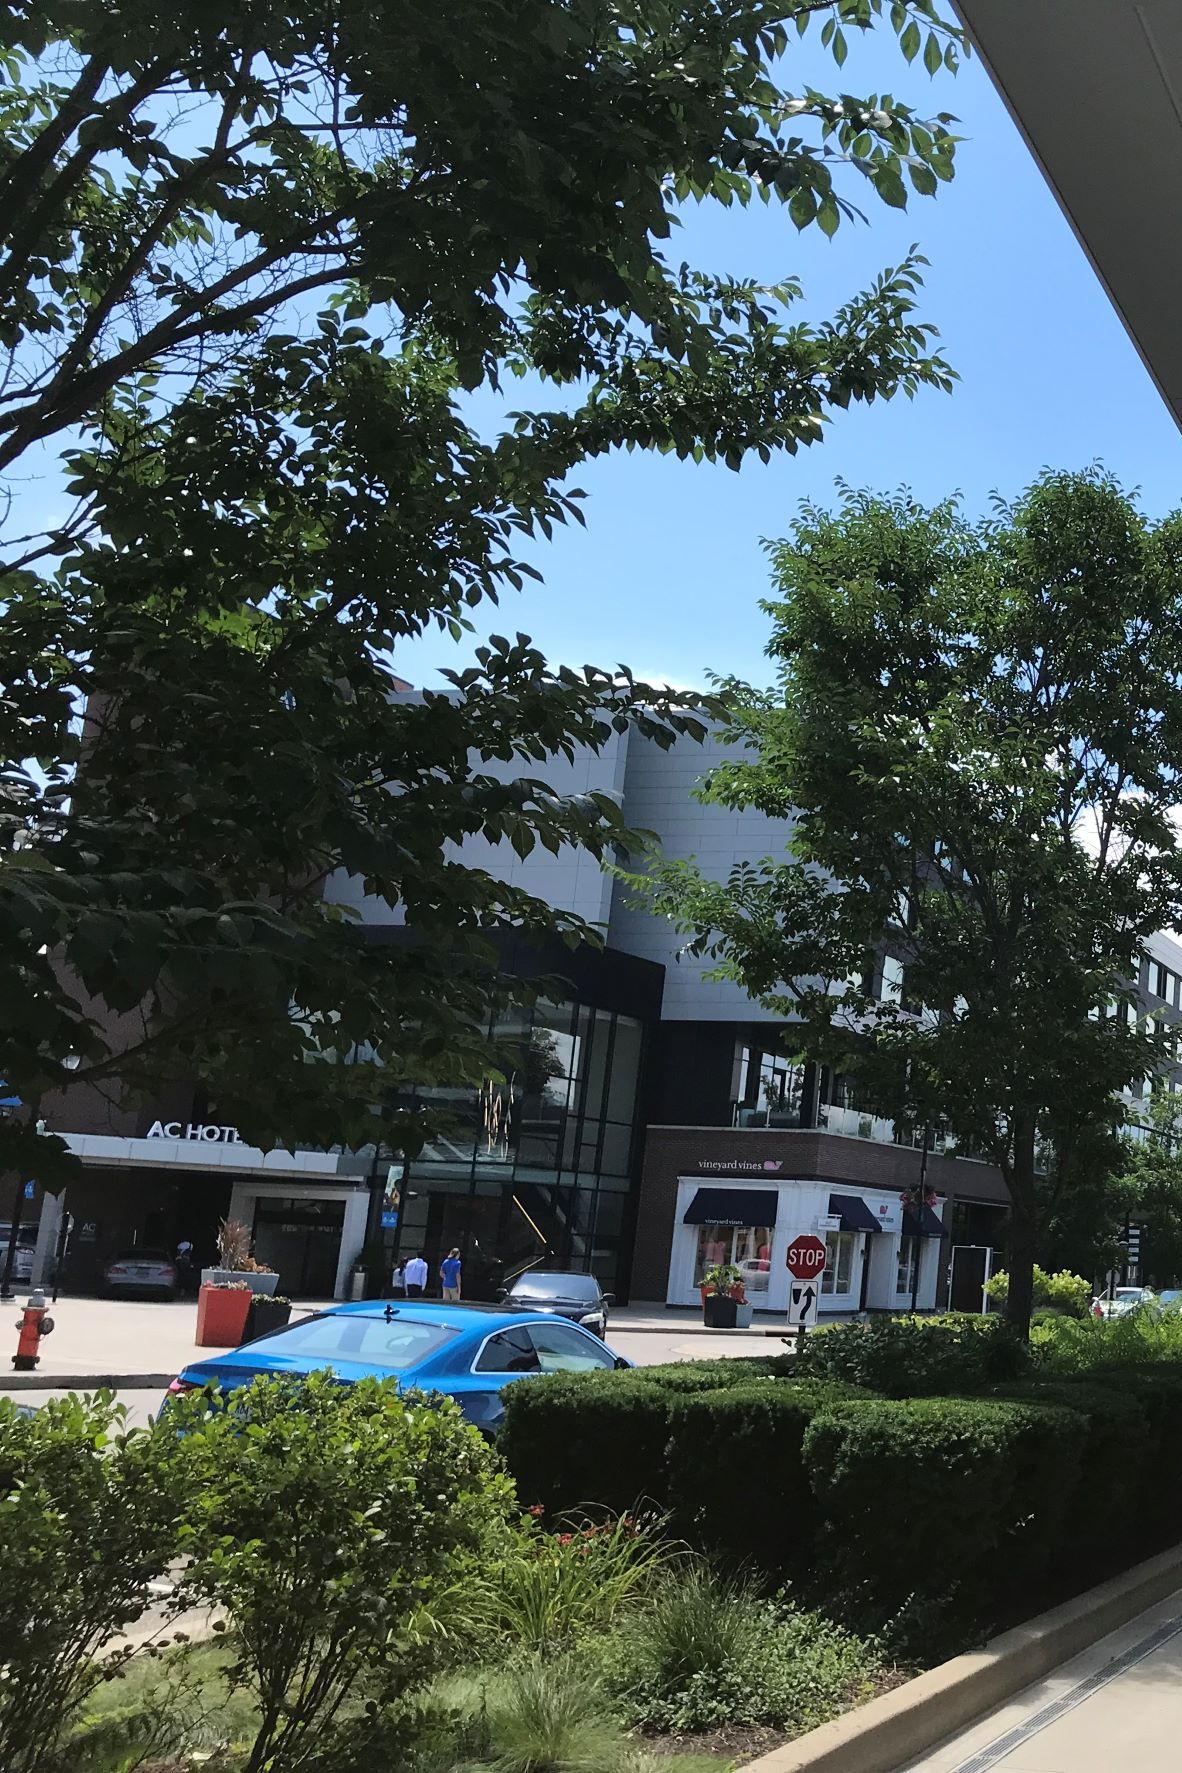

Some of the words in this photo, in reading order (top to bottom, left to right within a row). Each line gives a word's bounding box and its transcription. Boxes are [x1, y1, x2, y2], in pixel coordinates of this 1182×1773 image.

[146, 1120, 182, 1139] AC
[185, 1123, 243, 1144] HOTE
[698, 1159, 737, 1171] vineyard
[738, 1160, 762, 1170] vines
[704, 1218, 729, 1226] vineyard
[788, 1248, 825, 1267] STOP
